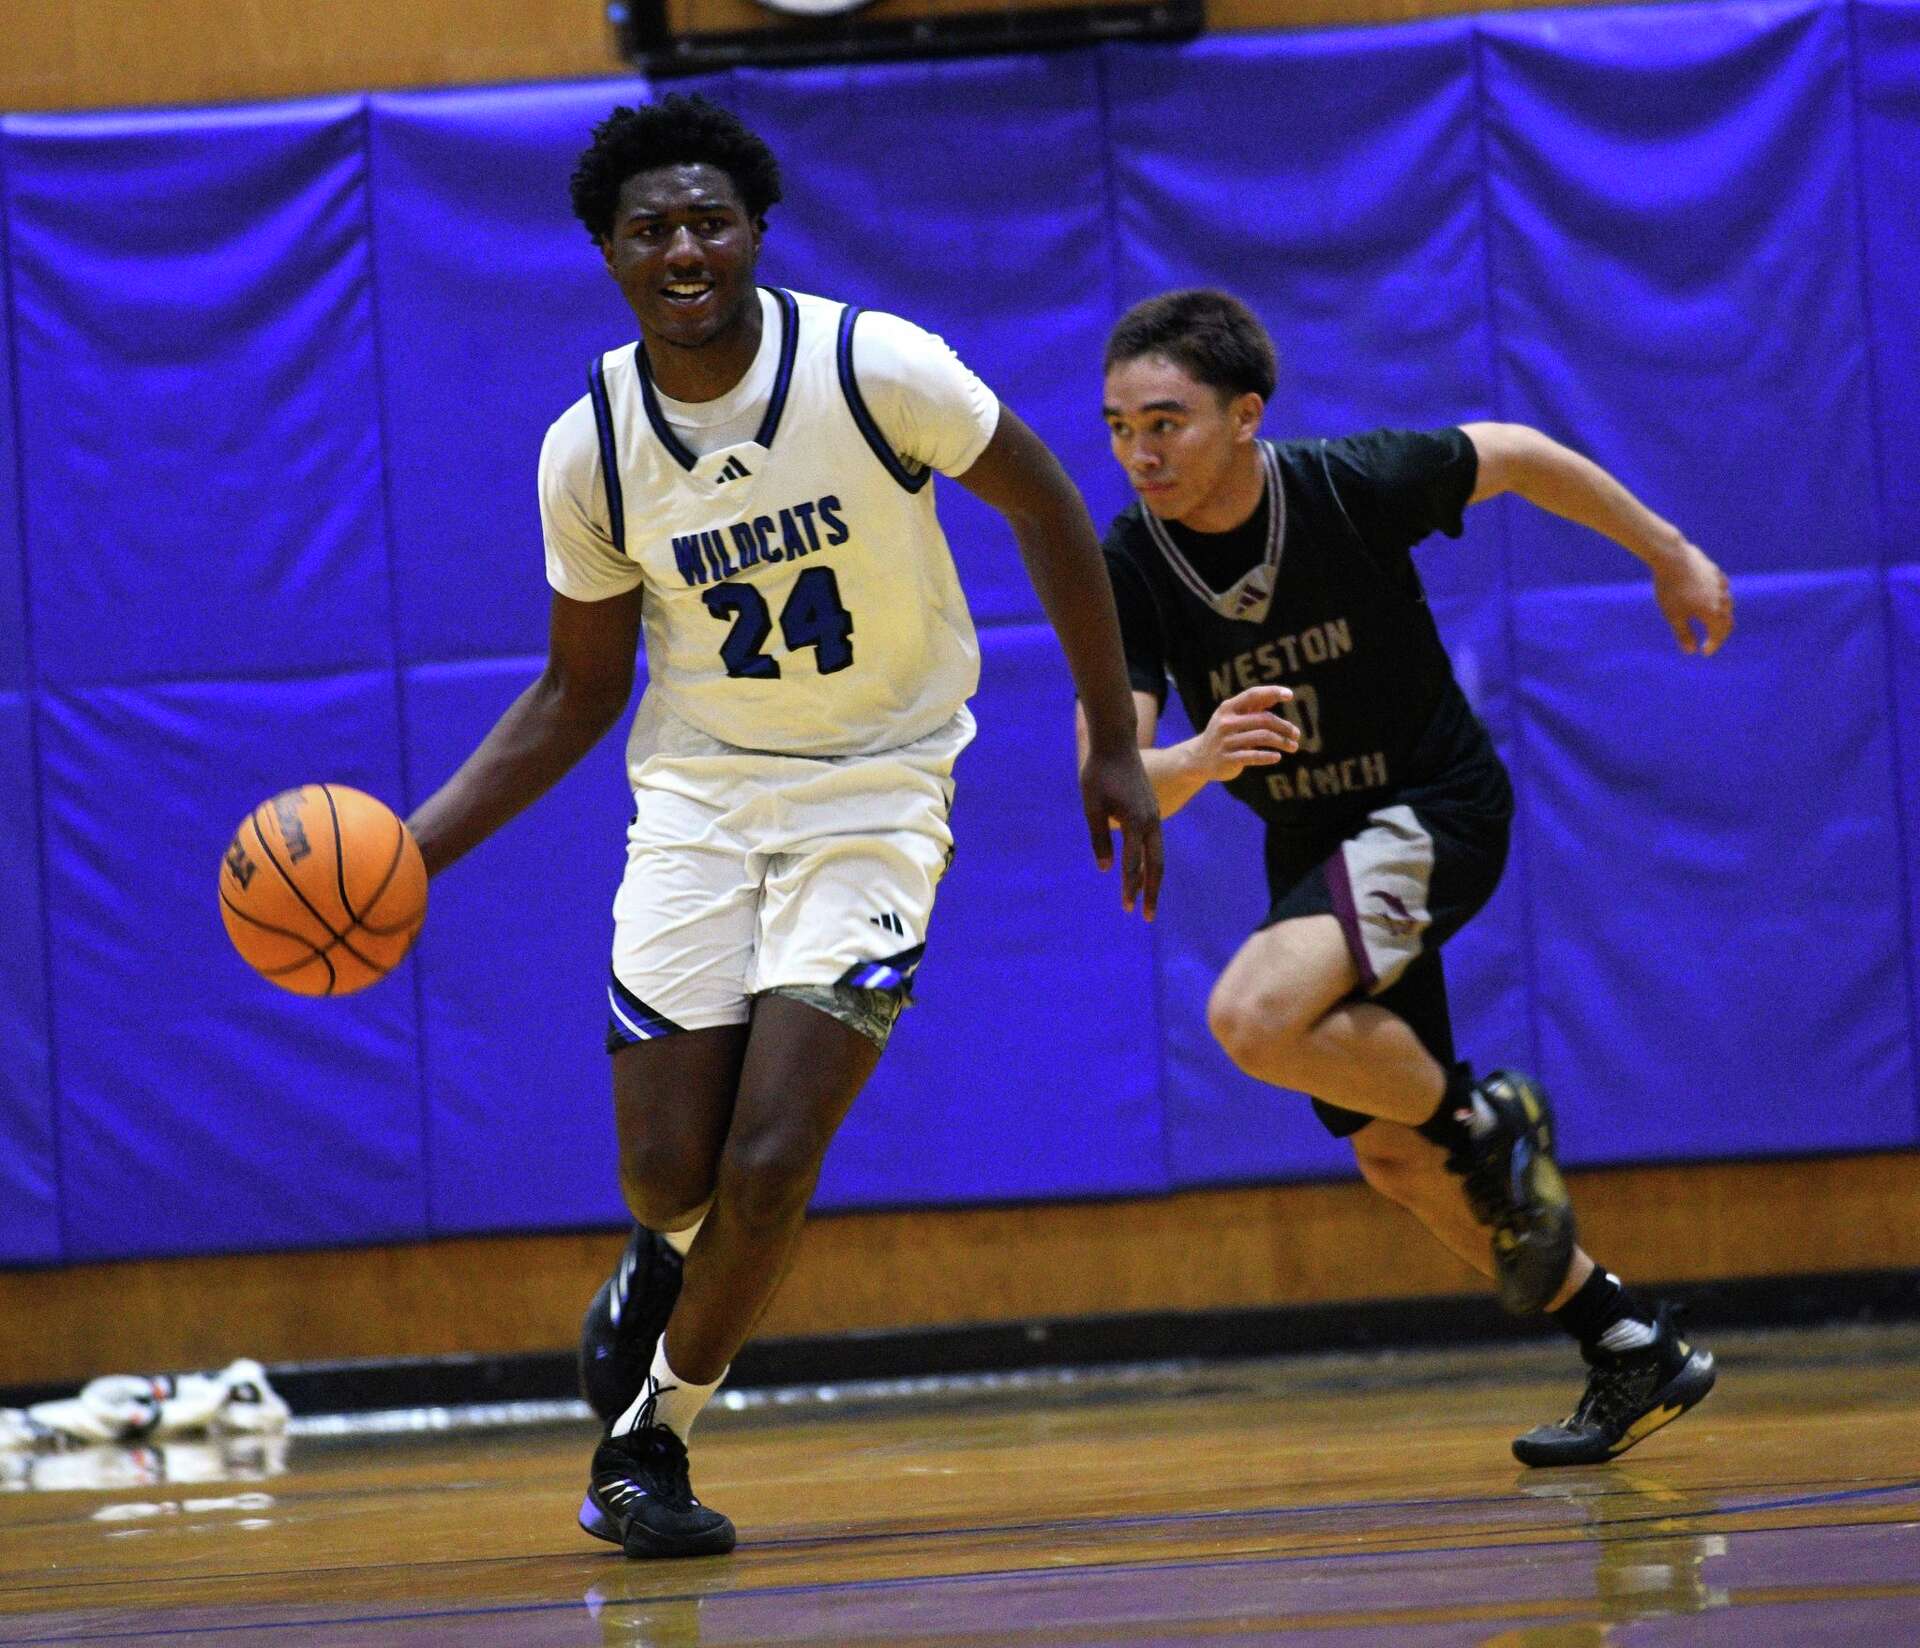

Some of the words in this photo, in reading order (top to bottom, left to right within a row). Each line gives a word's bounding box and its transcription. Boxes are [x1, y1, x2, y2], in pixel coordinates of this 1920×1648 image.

[672, 494, 849, 587] WILDCATS
[701, 565, 855, 680] 24
[1265, 751, 1389, 801] RANCH
